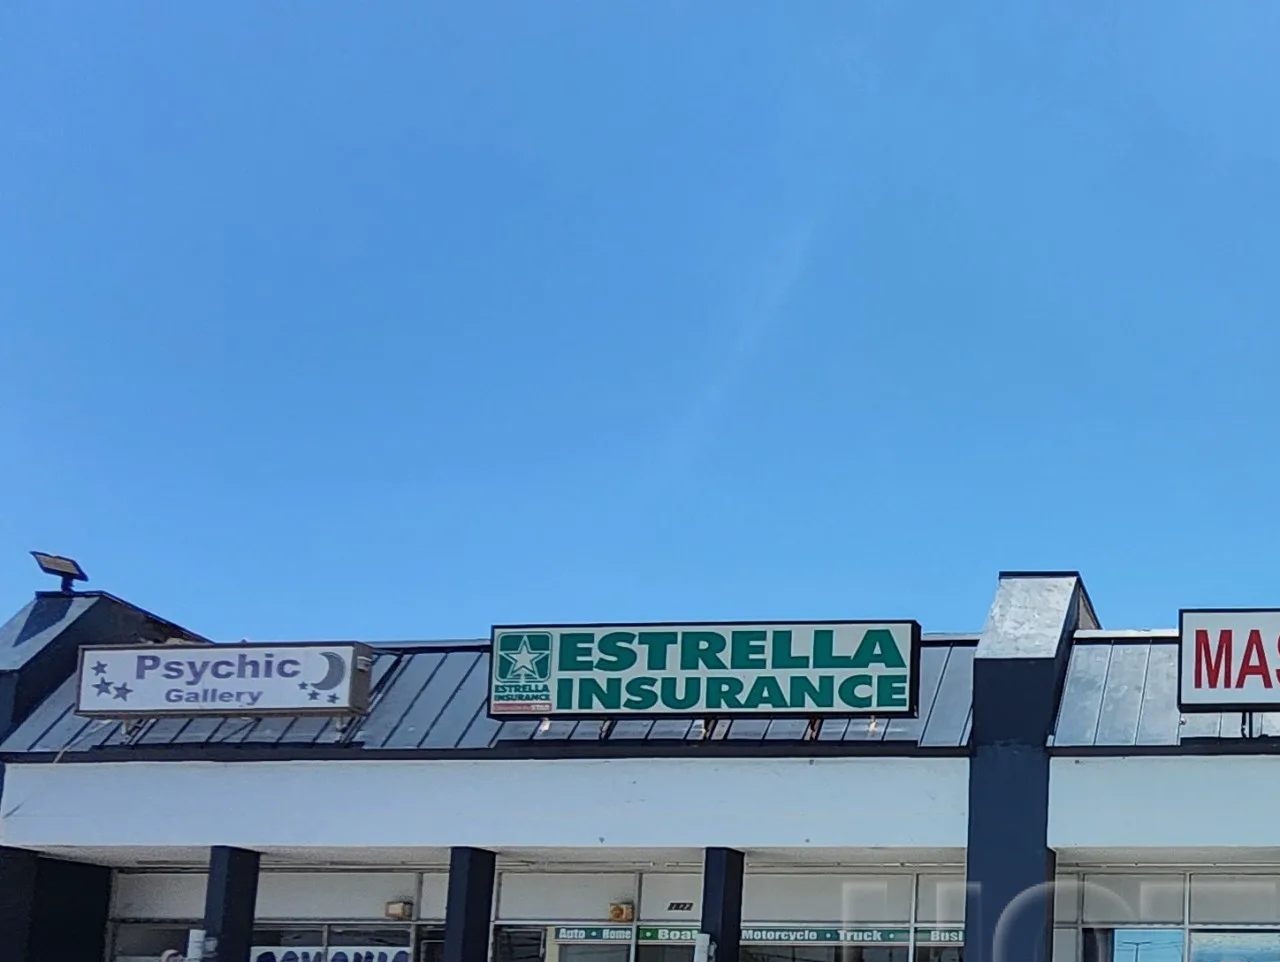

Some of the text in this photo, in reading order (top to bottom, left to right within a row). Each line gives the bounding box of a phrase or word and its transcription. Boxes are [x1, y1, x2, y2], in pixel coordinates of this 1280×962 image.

[558, 629, 907, 672] ESTRELLA
[136, 653, 301, 684] Psychic
[165, 688, 263, 707] Gallery
[494, 684, 550, 693] ESTRELLA
[556, 674, 908, 709] INSURANCE
[558, 928, 586, 939] Auto
[602, 928, 632, 940] Home
[657, 929, 698, 940] Boat
[741, 929, 817, 942] Motorcycle
[838, 930, 882, 941] Truck
